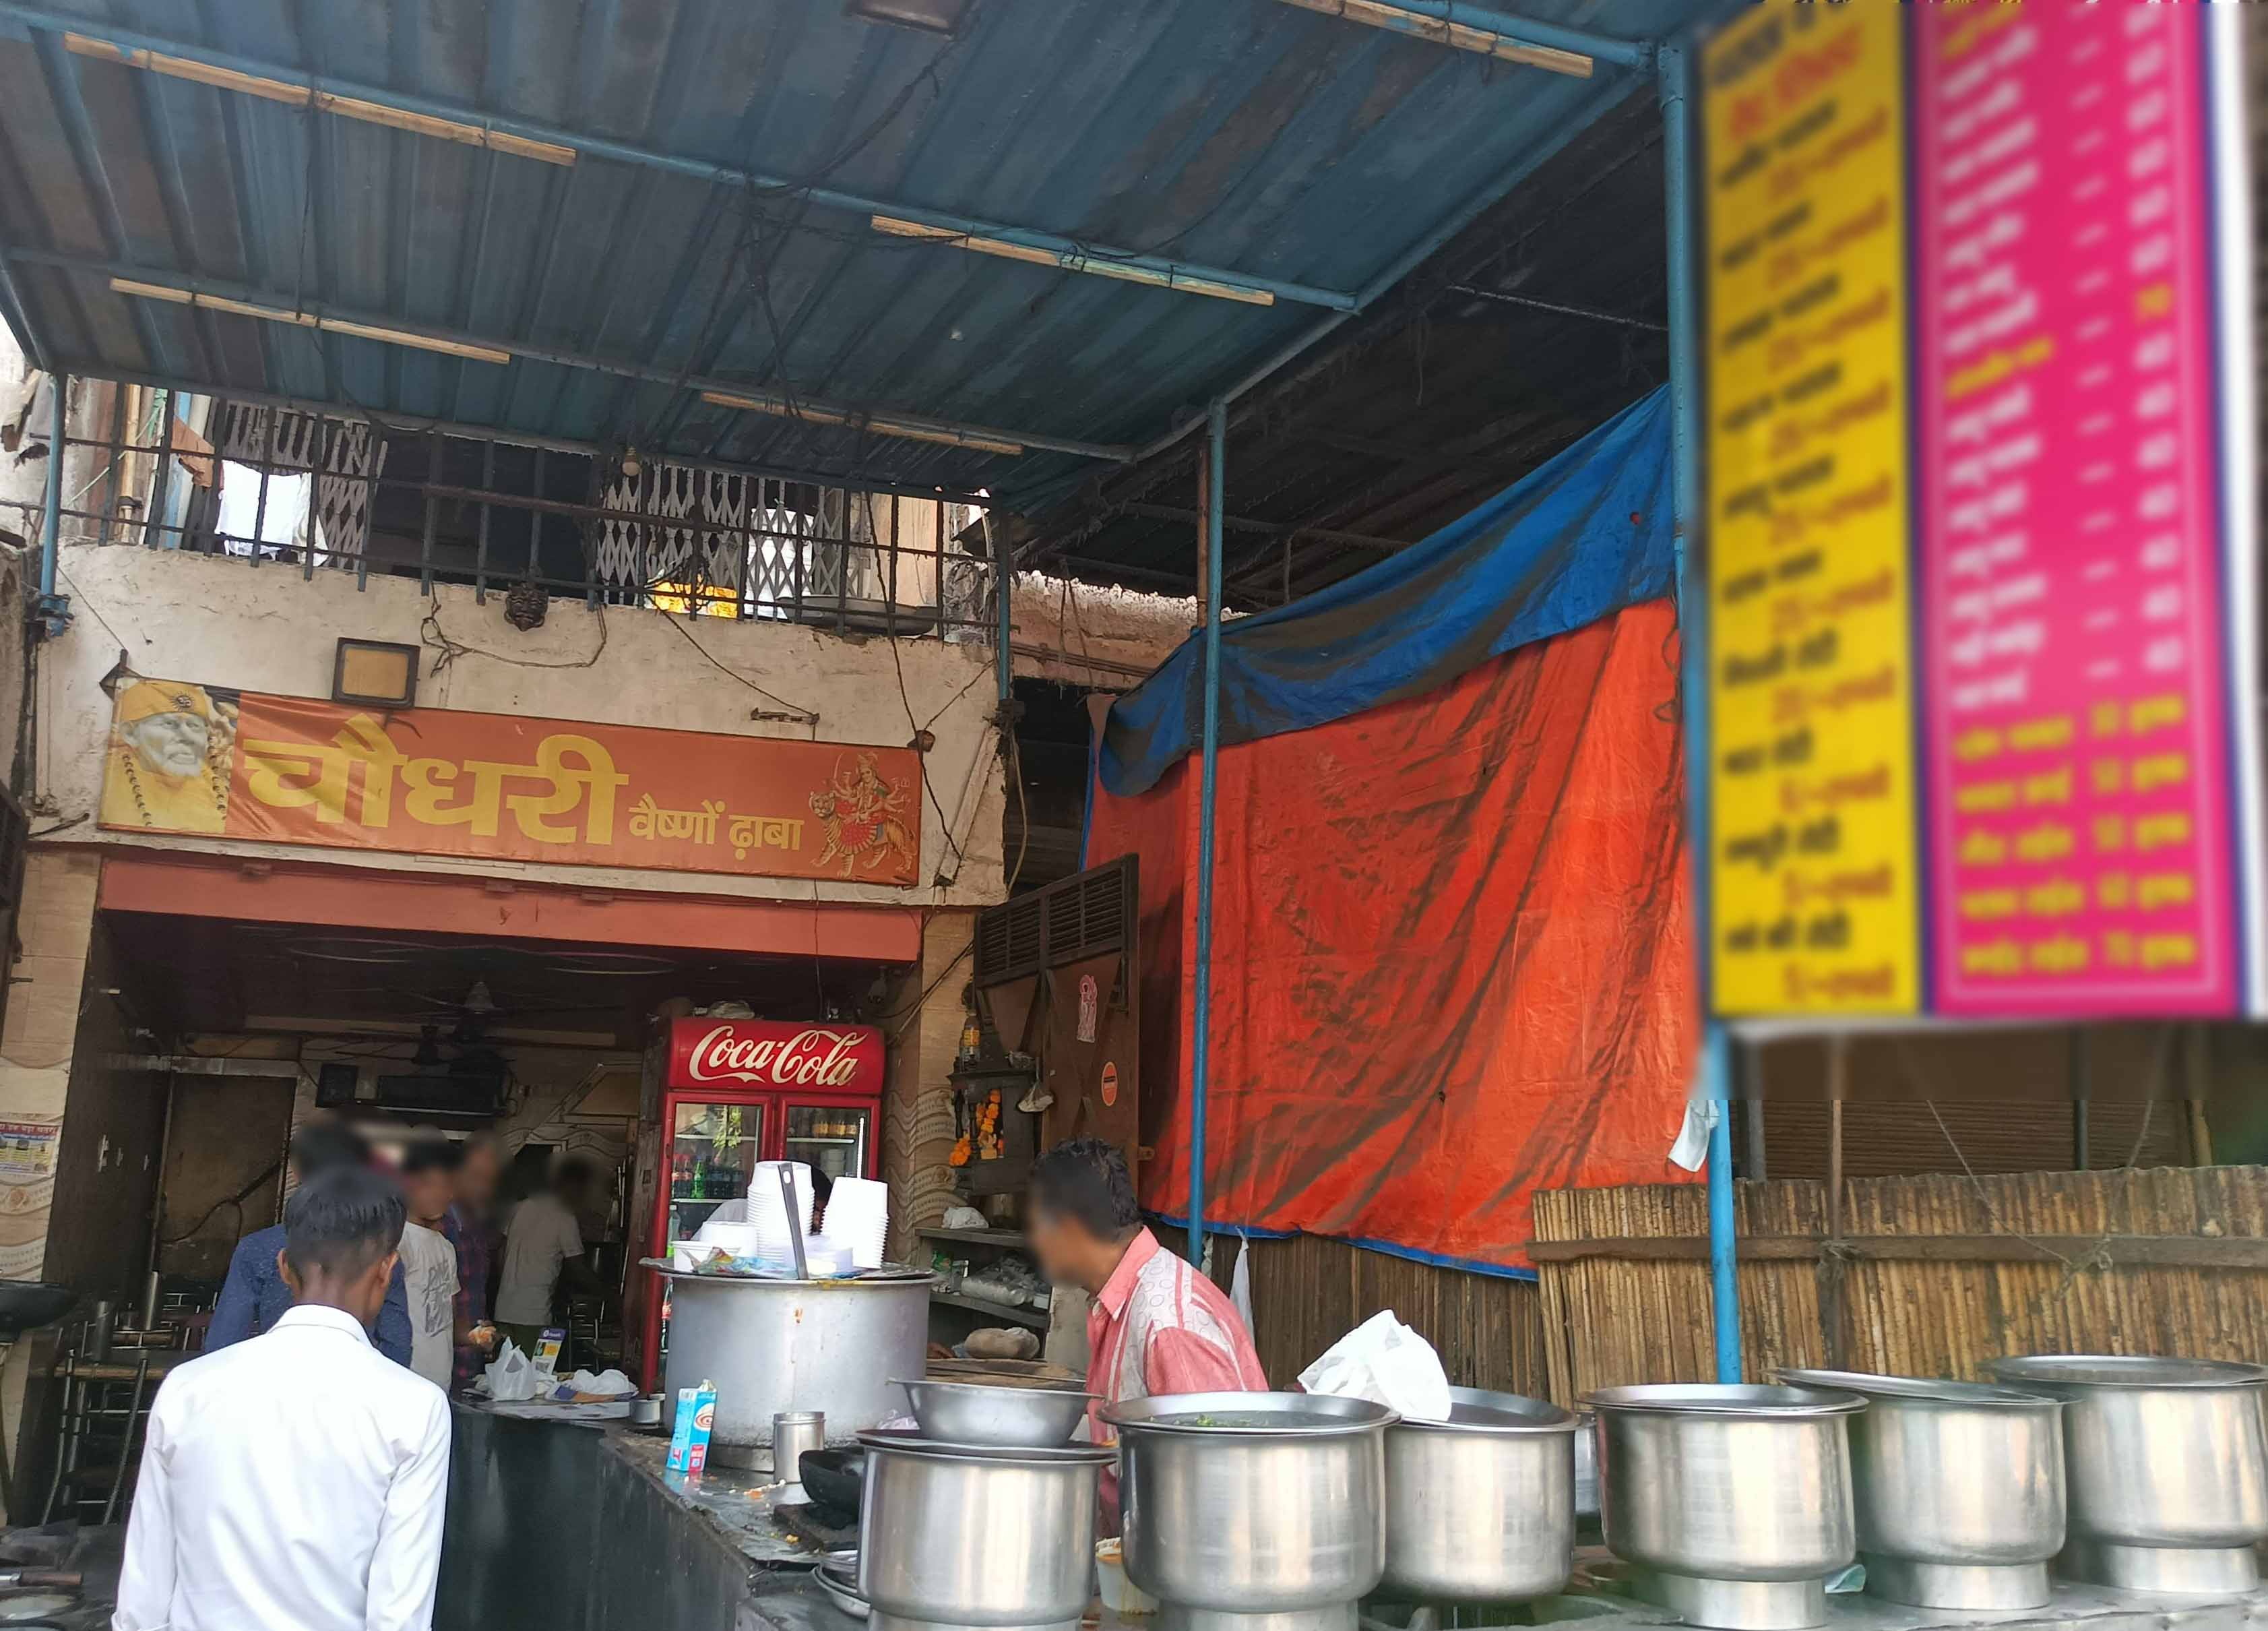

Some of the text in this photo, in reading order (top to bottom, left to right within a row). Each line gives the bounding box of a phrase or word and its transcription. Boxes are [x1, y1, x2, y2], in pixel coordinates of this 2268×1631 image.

[243, 713, 629, 845] चौधरी
[628, 792, 726, 844] वैष्णों
[689, 1025, 869, 1086] Coca-Cola
